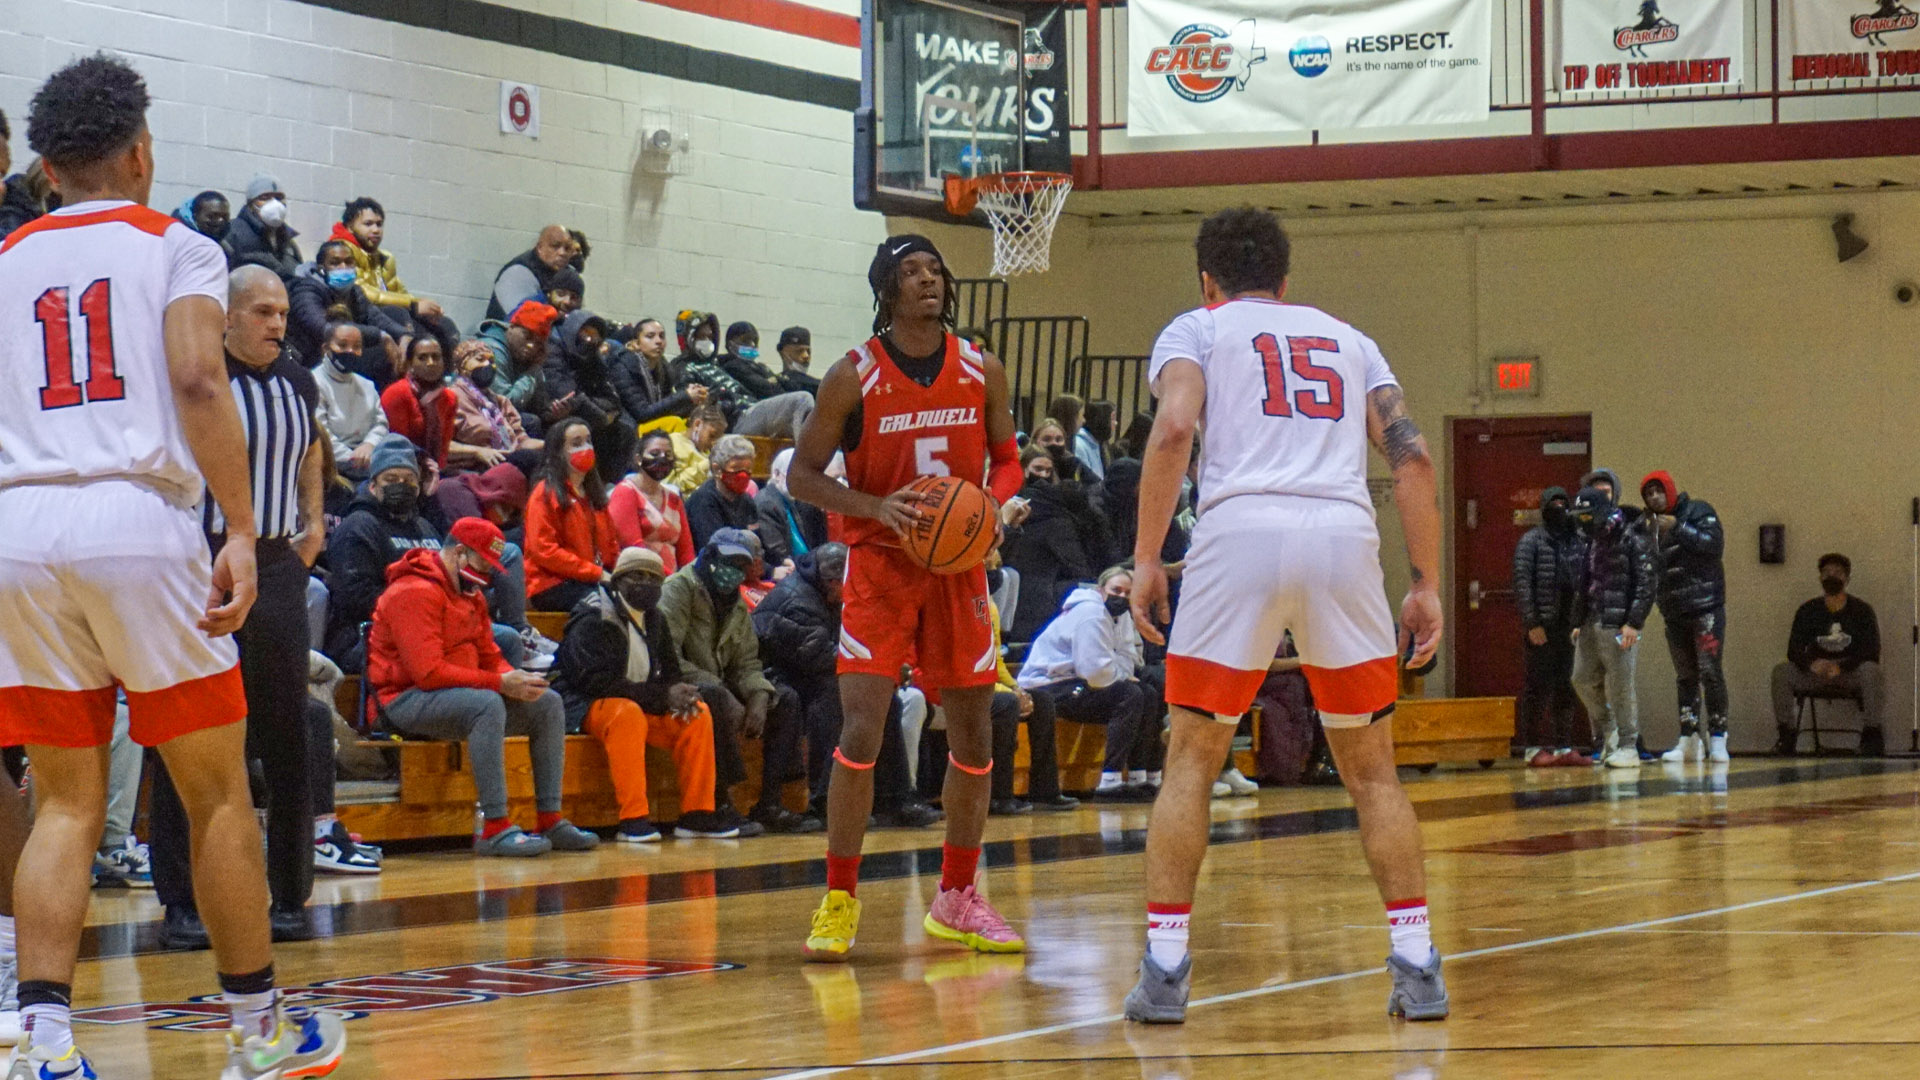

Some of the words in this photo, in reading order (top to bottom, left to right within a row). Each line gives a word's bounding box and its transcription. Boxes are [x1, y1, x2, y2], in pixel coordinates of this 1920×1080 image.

[916, 33, 1000, 65] MAKE
[1346, 32, 1454, 53] RESPECT.
[1145, 44, 1234, 74] CACC
[1293, 52, 1333, 68] NCAA
[1346, 62, 1361, 72] It's
[1365, 60, 1381, 71] the
[1384, 61, 1414, 71] name
[1417, 59, 1428, 70] of
[1430, 58, 1446, 69] the
[1449, 57, 1482, 69] game.
[1564, 64, 1589, 90] TIP
[1595, 63, 1622, 89] OFF
[1627, 57, 1731, 88] TOURNAMENT
[1792, 52, 1871, 80] MEMORIAL
[34, 278, 126, 411] 11
[1251, 332, 1344, 422] 15
[1499, 363, 1532, 389] EXIT
[878, 407, 978, 434] CALDWELL
[914, 436, 951, 478] 5
